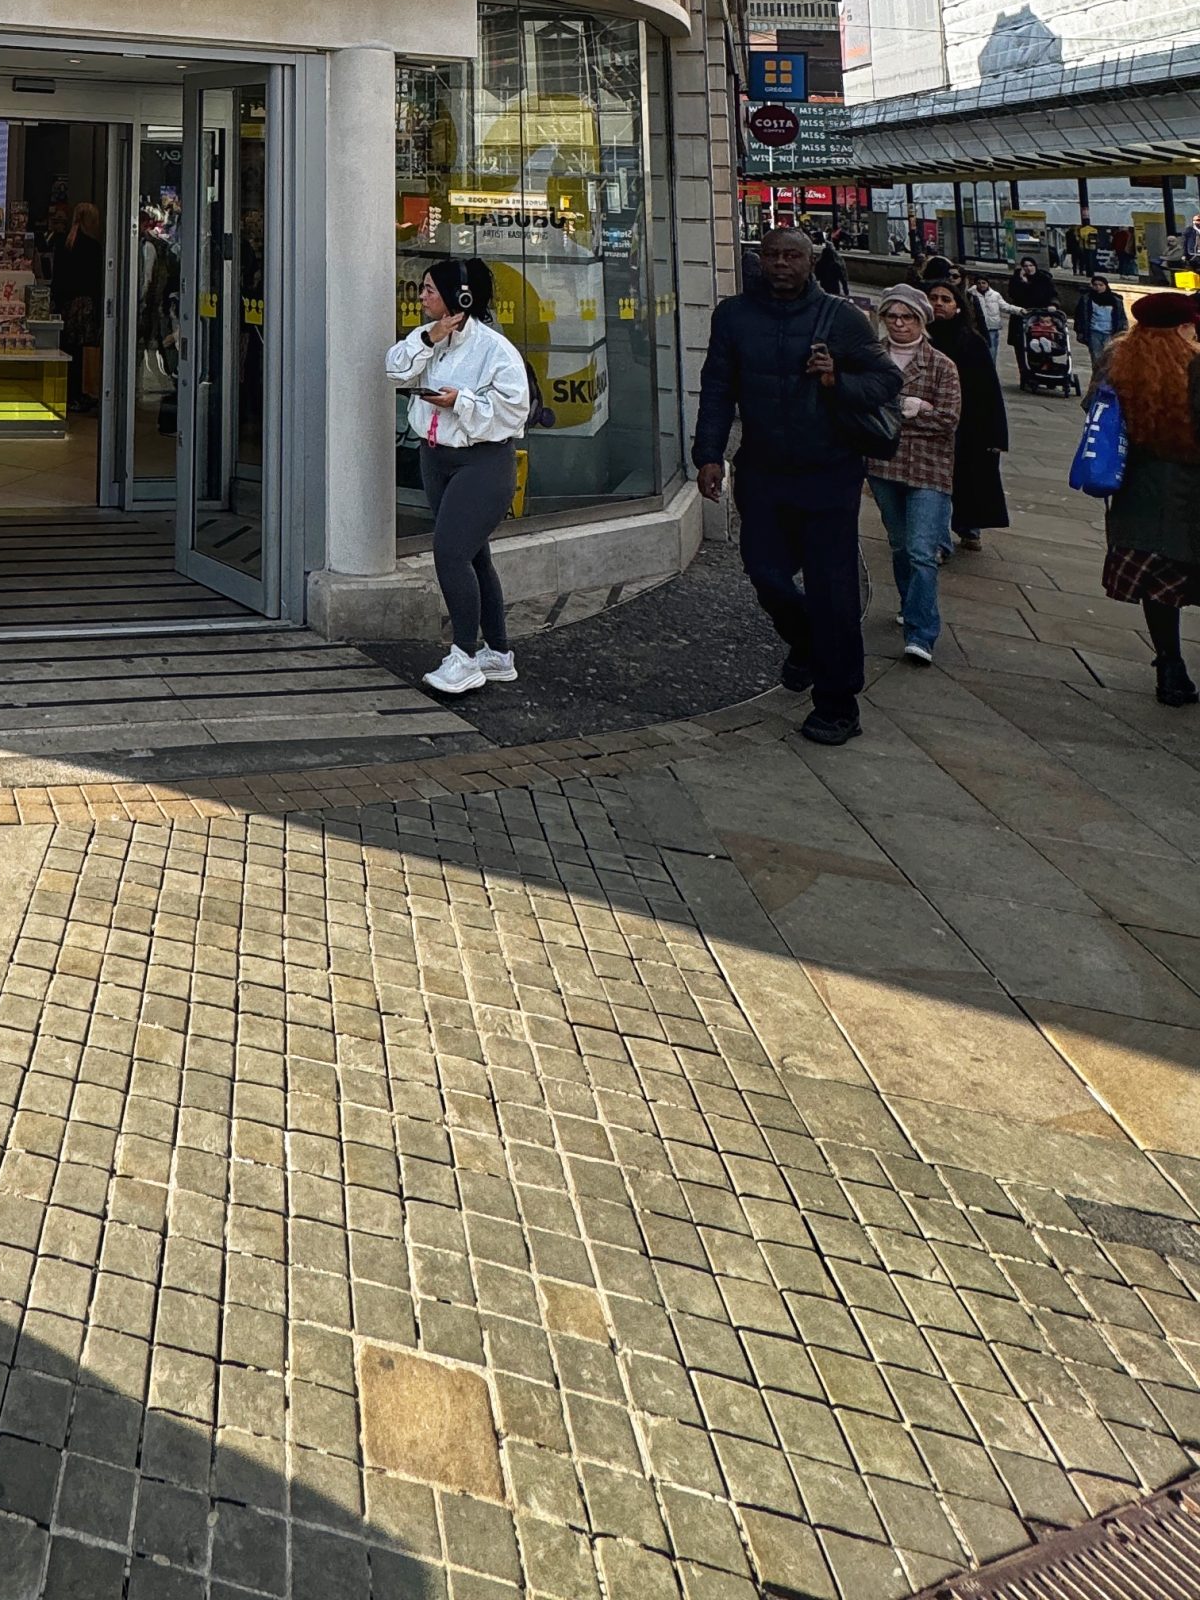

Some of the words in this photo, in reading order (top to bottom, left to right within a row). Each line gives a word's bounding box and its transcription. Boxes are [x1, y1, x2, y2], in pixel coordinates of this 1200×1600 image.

[800, 107, 825, 116] MISS
[755, 118, 794, 129] COSTA
[800, 119, 825, 127] MISS
[801, 131, 826, 139] MISS
[801, 144, 827, 152] MISS
[482, 229, 504, 239] ARTIST
